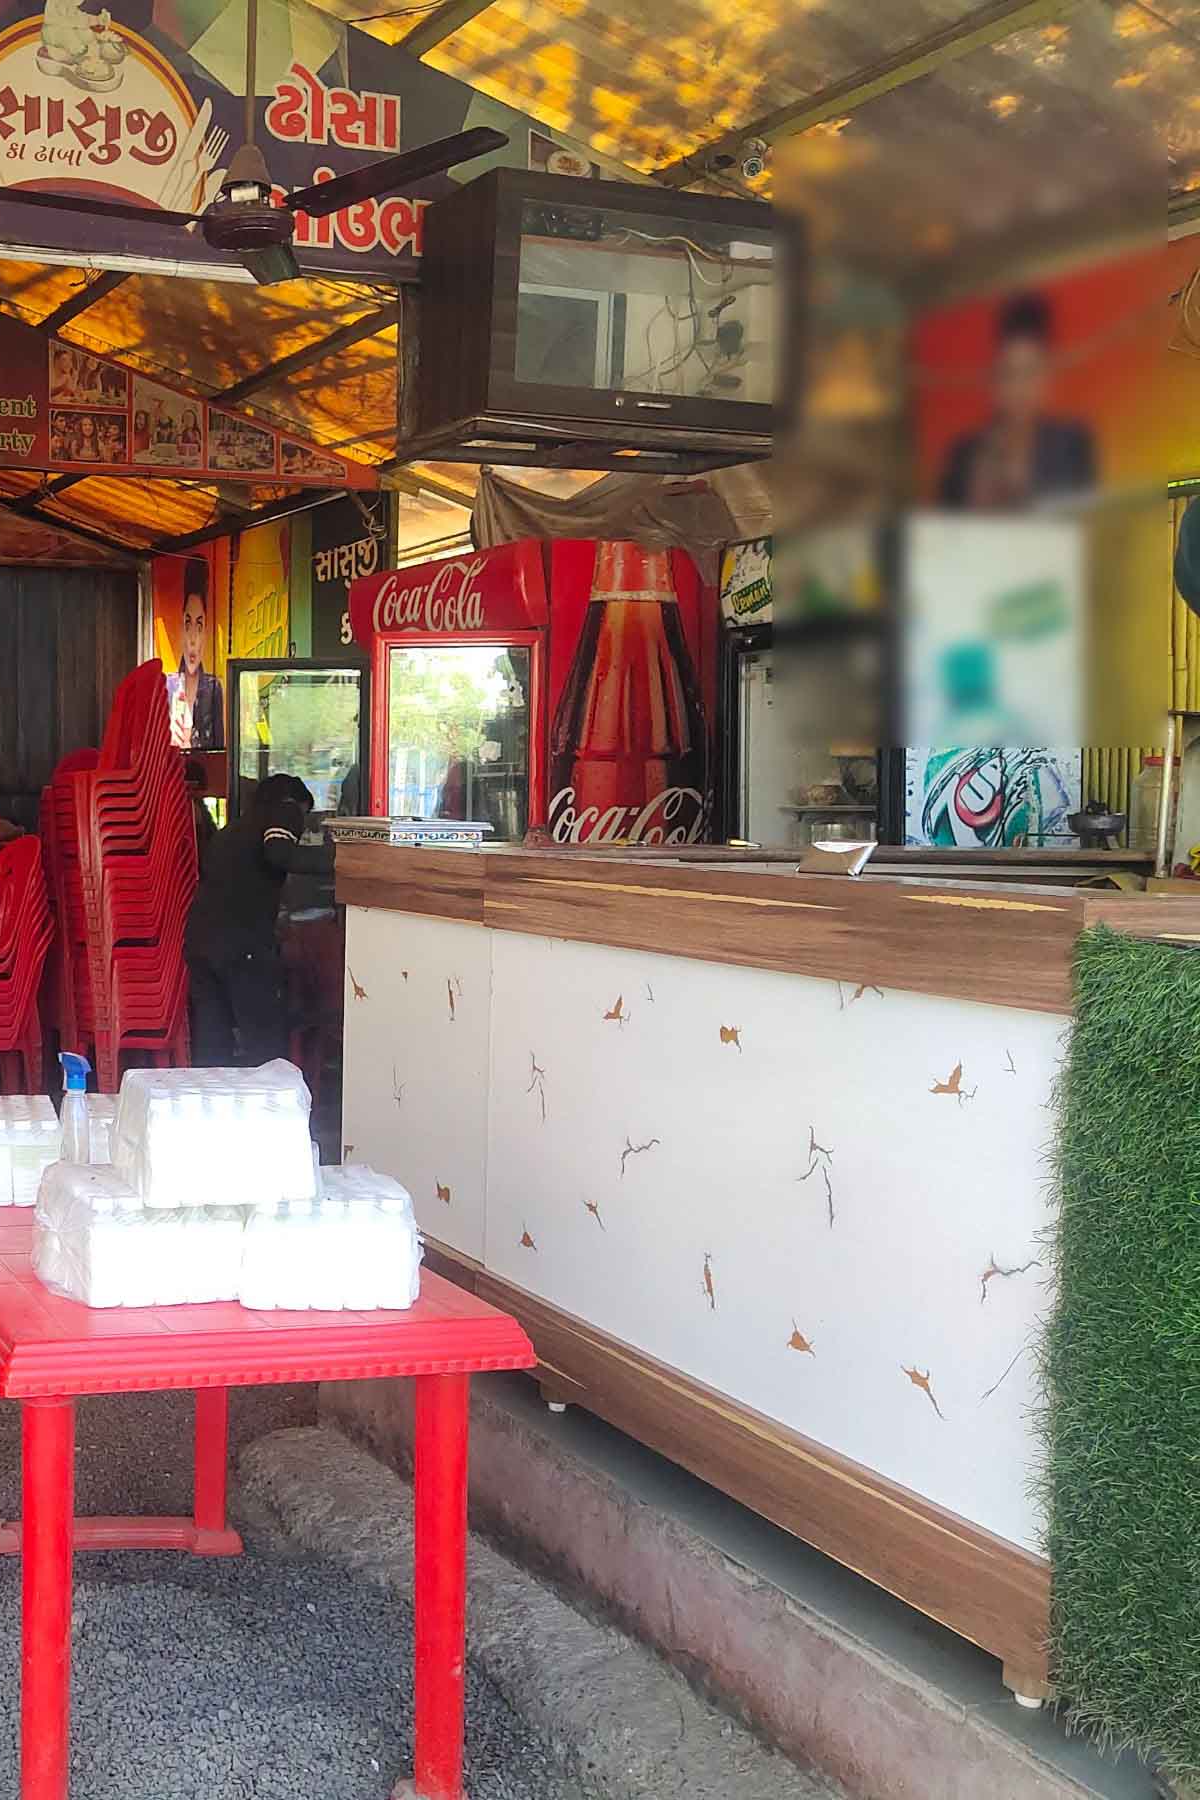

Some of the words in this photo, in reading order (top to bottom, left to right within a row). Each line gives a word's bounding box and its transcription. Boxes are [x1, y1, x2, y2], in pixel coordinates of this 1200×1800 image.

[265, 59, 400, 153] ઢોસા
[6, 142, 26, 160] કા
[373, 557, 489, 632] Coca-Cola
[549, 787, 705, 844] Coca-Col
